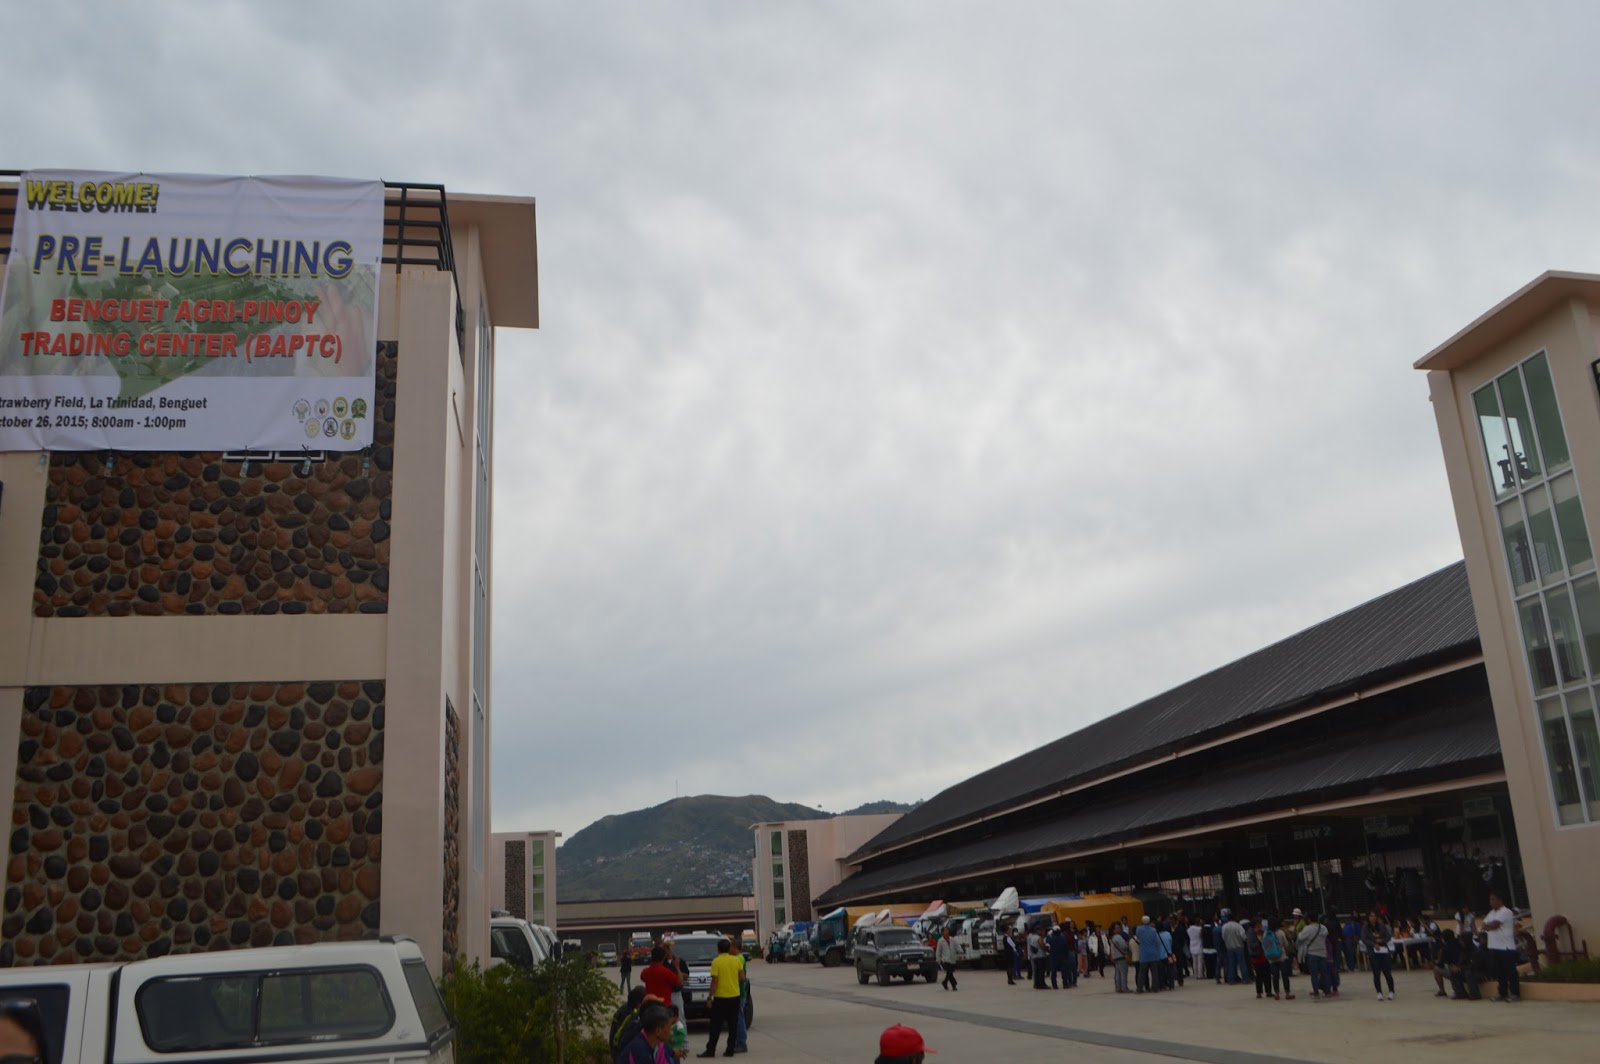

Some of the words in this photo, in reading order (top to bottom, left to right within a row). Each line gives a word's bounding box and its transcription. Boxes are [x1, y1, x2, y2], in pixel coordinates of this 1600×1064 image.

[25, 180, 160, 213] WELCOME!
[32, 233, 354, 279] PRE-LAUNCHING
[50, 298, 169, 322] BENGUET
[174, 300, 320, 324] AGRI-PINOY
[20, 331, 130, 357] TRADING
[138, 332, 238, 357] CENTER
[244, 333, 343, 364] (BAPTC)
[54, 396, 86, 410] Field,
[90, 397, 103, 408] La
[106, 396, 156, 410] Trinidad,
[159, 397, 207, 411] Benguet
[0, 416, 33, 428] tober
[35, 415, 52, 429] 26,
[55, 415, 89, 430] 2015;
[91, 416, 134, 428] 8:00am
[144, 416, 187, 430] 1:00pm
